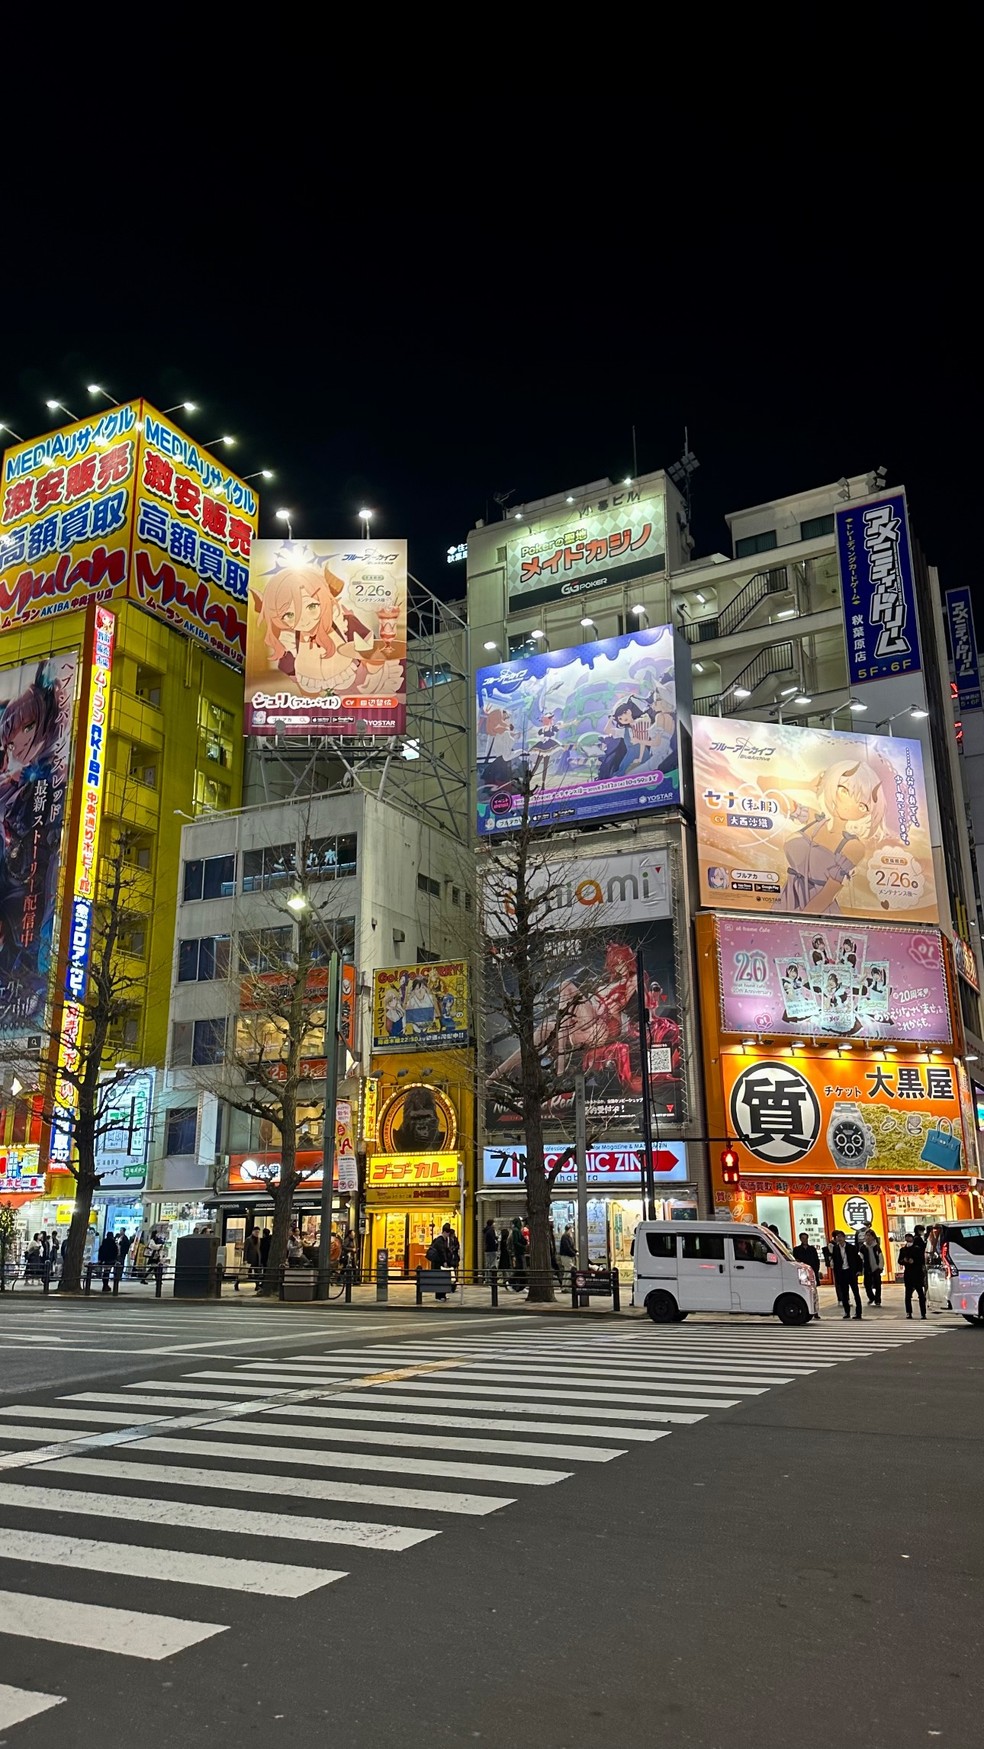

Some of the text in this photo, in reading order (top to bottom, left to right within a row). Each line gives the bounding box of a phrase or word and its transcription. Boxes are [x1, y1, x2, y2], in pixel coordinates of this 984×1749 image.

[2, 440, 132, 524] 激安販売
[142, 450, 253, 558] 激安販売
[0, 489, 128, 570] 高額買取
[138, 498, 249, 600] 高額買取
[519, 523, 652, 582] メイドカジノ
[521, 528, 588, 557] Pokerの聖地
[0, 547, 126, 615] Mulan
[851, 614, 867, 663] 秋葉原店
[51, 662, 74, 823] ヘブンバーンズレッド
[367, 719, 396, 727] YOSTAR
[647, 791, 674, 802] YOSTAR
[741, 1075, 815, 1151] 質
[824, 1066, 955, 1101] チケット 大黒屋
[373, 1162, 455, 1179] ゴーゴーカレー
[846, 1201, 869, 1227] 質
